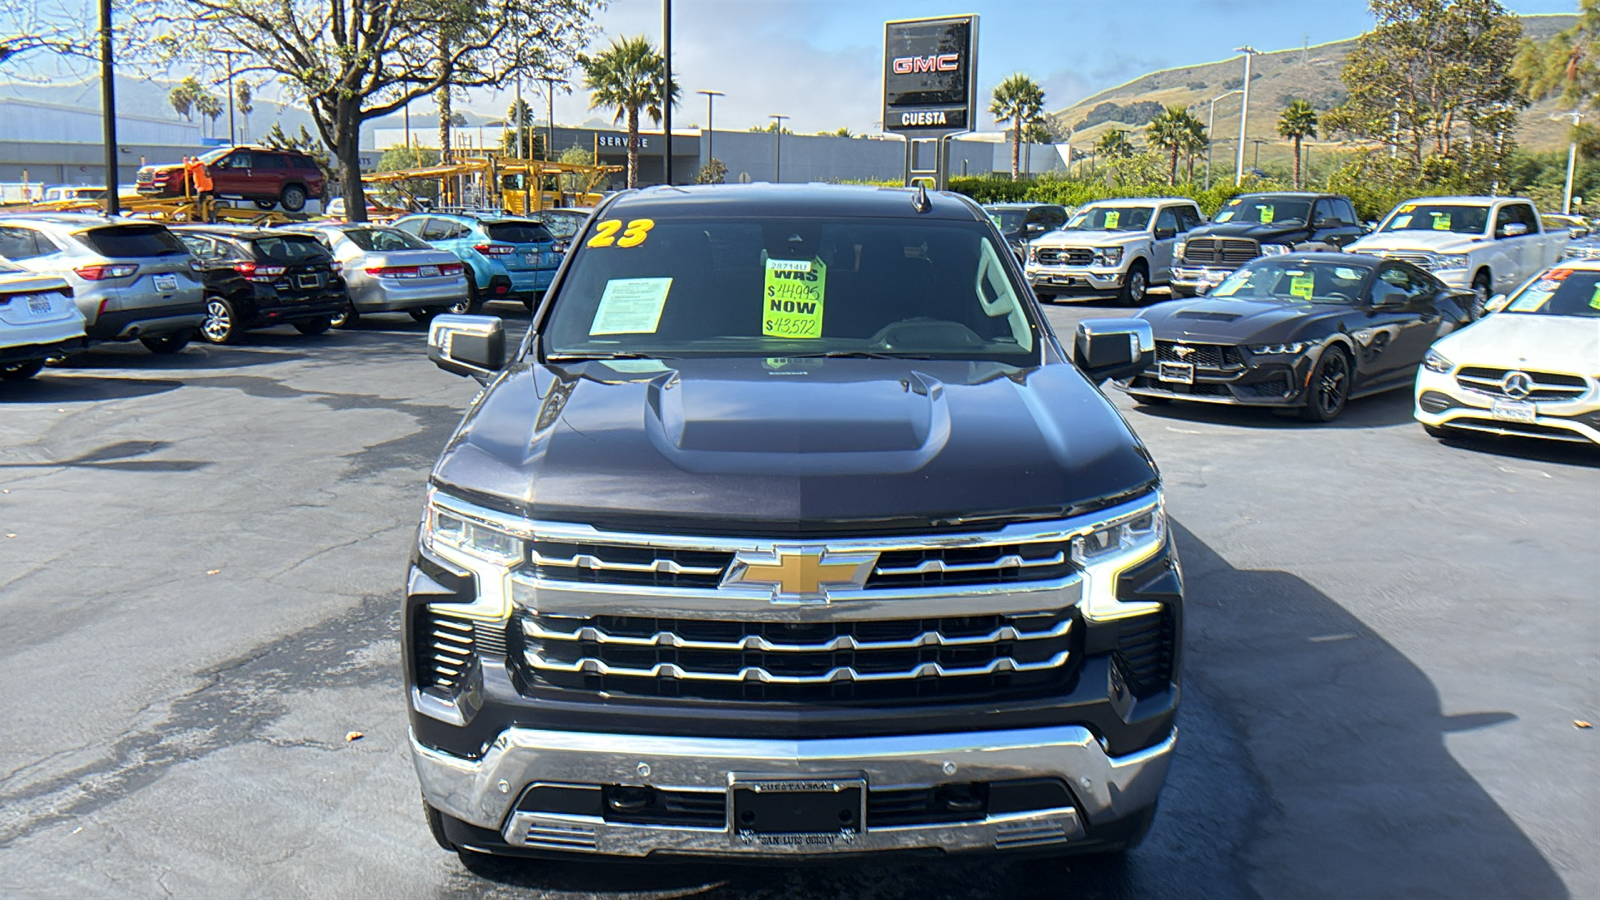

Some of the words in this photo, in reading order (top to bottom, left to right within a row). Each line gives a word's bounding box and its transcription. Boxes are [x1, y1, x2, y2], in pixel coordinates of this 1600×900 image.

[893, 53, 959, 74] GMC
[901, 111, 947, 126] CUESTA
[599, 136, 648, 148] SERVE
[586, 218, 655, 248] 23
[774, 269, 818, 282] WAS
[770, 299, 817, 315] NOW
